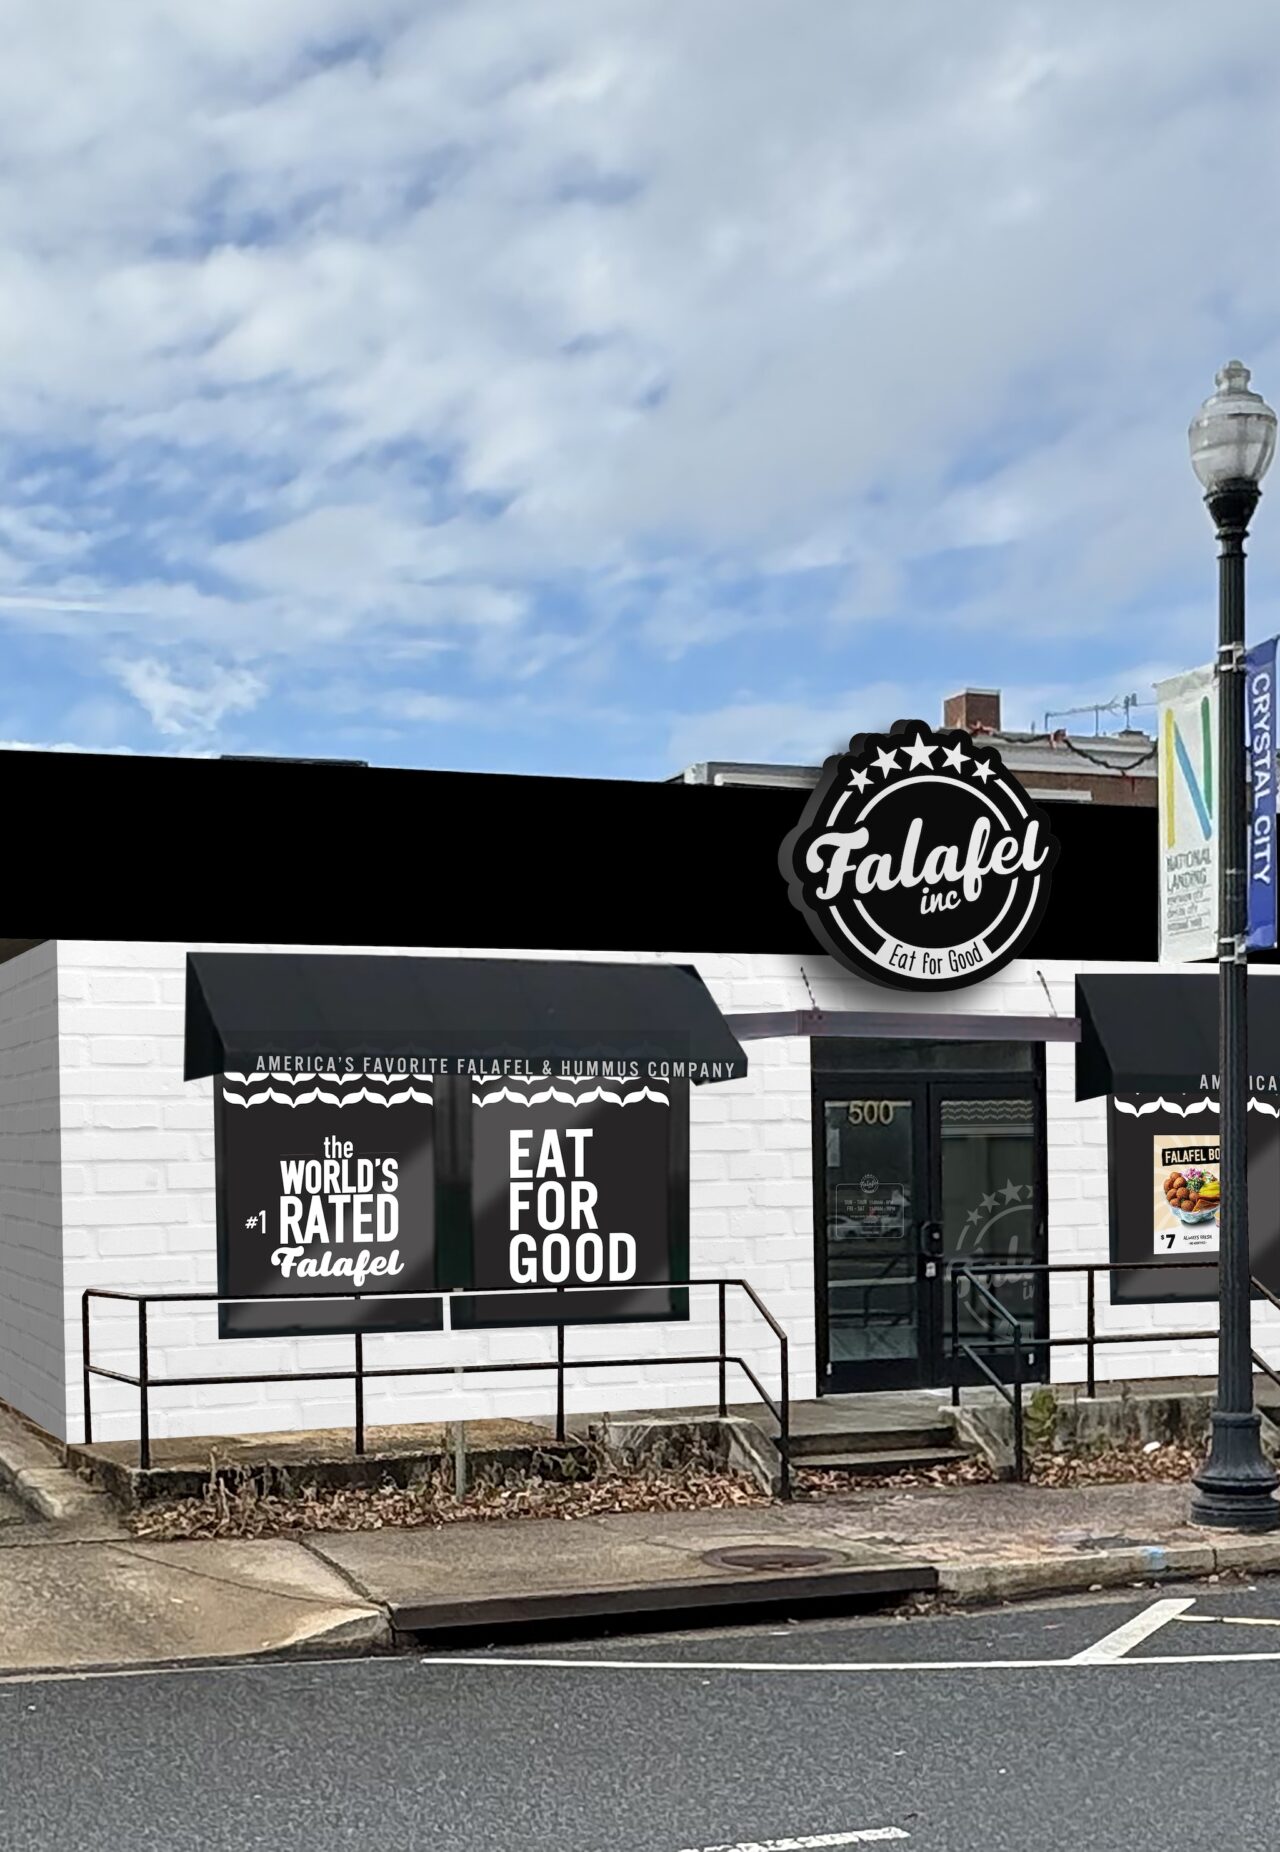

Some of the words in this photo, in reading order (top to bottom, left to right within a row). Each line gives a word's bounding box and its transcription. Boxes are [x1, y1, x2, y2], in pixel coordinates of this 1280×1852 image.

[1251, 672, 1272, 808] CRYSTAL
[806, 816, 1049, 900] Falafel
[1253, 816, 1272, 885] CITY
[920, 887, 961, 915] inc
[889, 943, 916, 972] Eat
[922, 958, 943, 975] for
[949, 941, 984, 973] Good
[256, 1055, 355, 1073] AMERICA'S
[363, 1057, 449, 1074] FAVORITE
[457, 1058, 534, 1076] FALAFEL
[542, 1060, 553, 1076] &
[561, 1060, 640, 1077] HUMMUS
[647, 1061, 735, 1079] COMPANY
[848, 1101, 893, 1125] 500
[323, 1135, 354, 1159] the
[509, 1128, 593, 1179] EAT
[1165, 1149, 1206, 1164] FALAFEL
[1208, 1148, 1220, 1161] BO
[280, 1158, 399, 1195] WORLD'S
[245, 1210, 266, 1234] #1
[280, 1193, 399, 1245] RATED
[509, 1180, 599, 1231] FOR
[509, 1232, 637, 1284] GOOD
[1161, 1234, 1176, 1249] $7
[270, 1246, 405, 1287] Falafel
